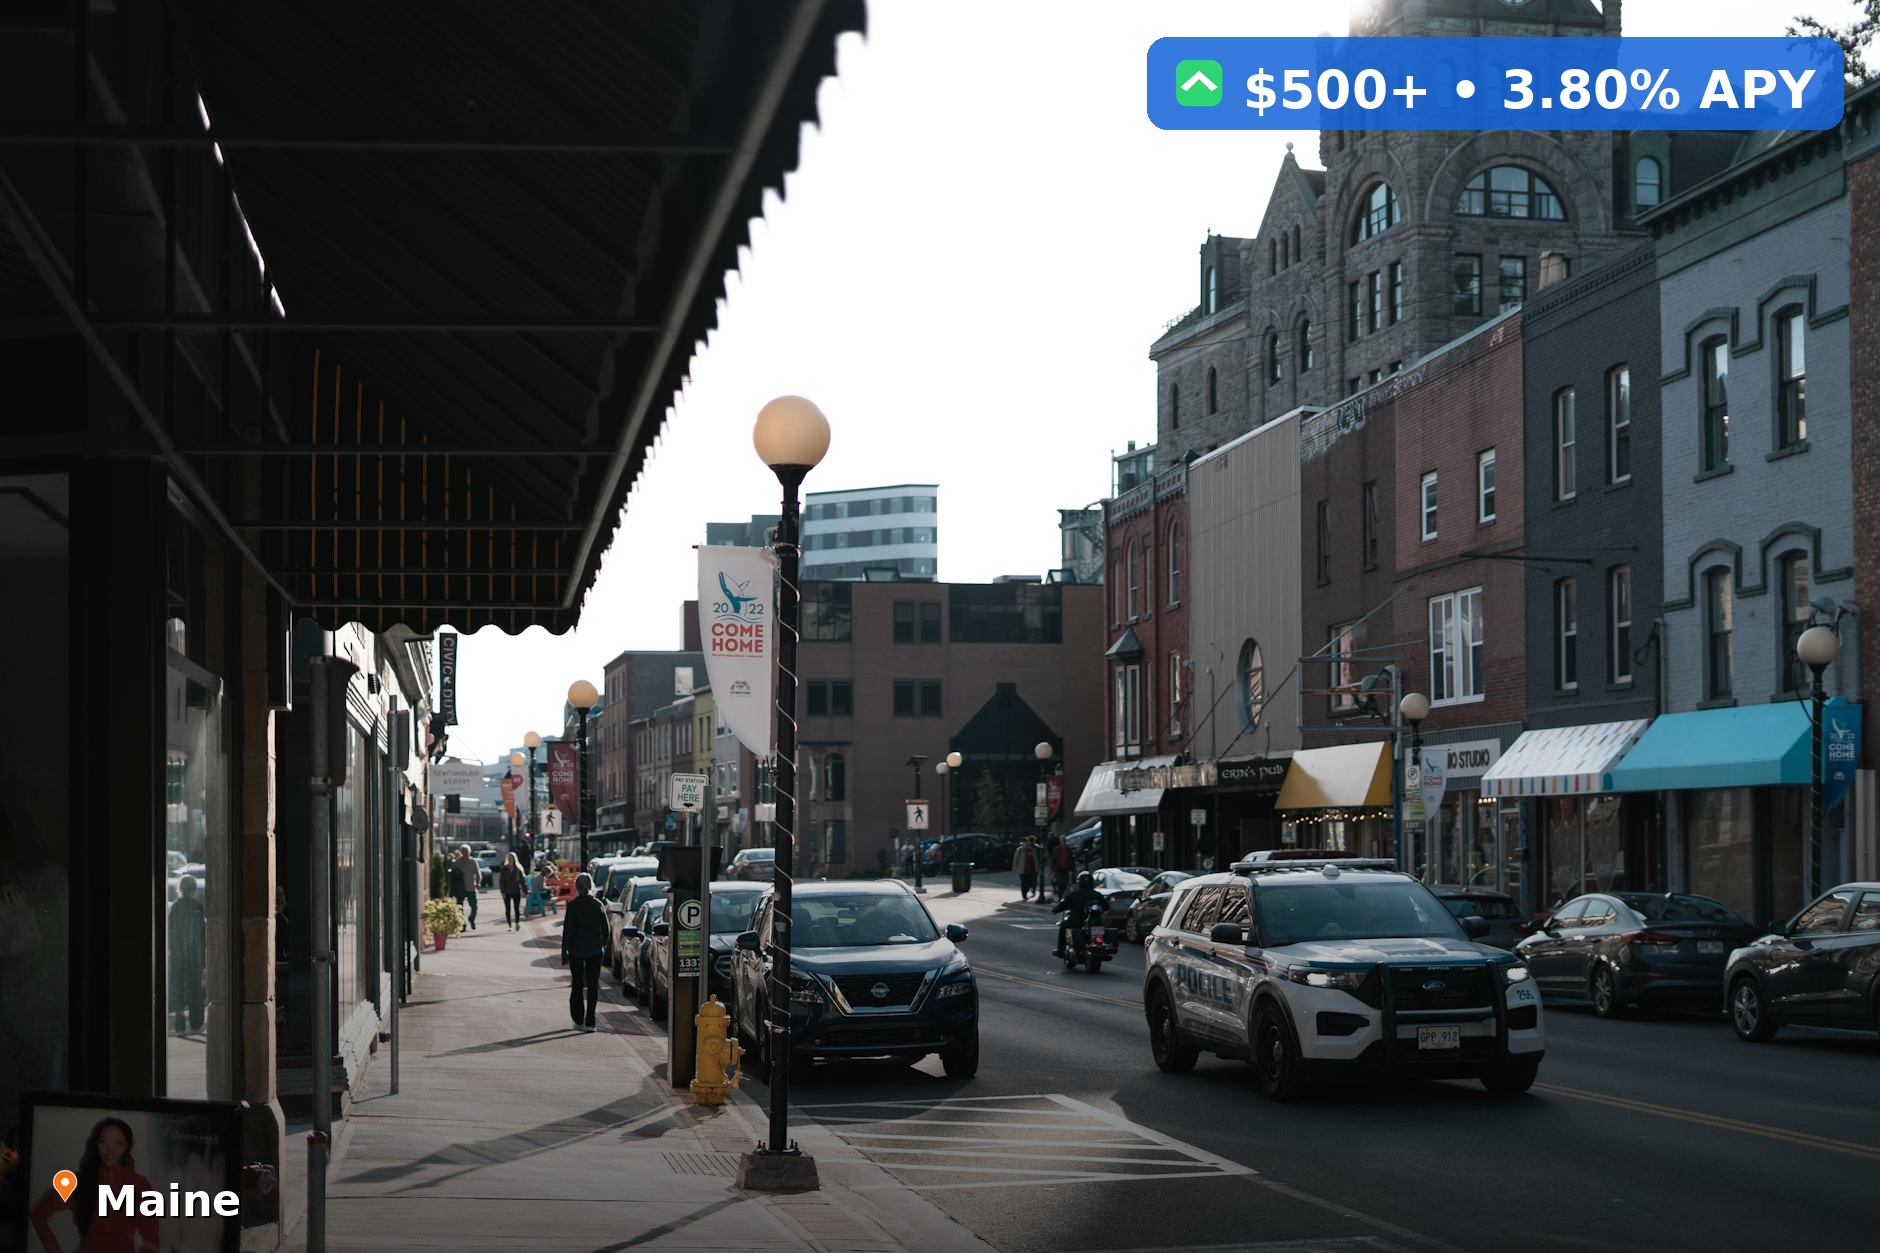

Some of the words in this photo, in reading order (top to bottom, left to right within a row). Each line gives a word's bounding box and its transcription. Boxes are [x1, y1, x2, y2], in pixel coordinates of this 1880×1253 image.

[713, 602, 729, 613] 20
[748, 603, 763, 614] 22
[711, 623, 763, 638] COME
[711, 638, 763, 653] HOME
[1828, 743, 1855, 751] COME
[1458, 748, 1490, 769] STUDIO
[1828, 751, 1855, 759] HOME
[682, 784, 697, 793] PAY
[677, 793, 701, 802] HERE
[1177, 963, 1234, 1004] POLICE
[1420, 1031, 1437, 1042] GPP
[1441, 1031, 1458, 1042] 912
